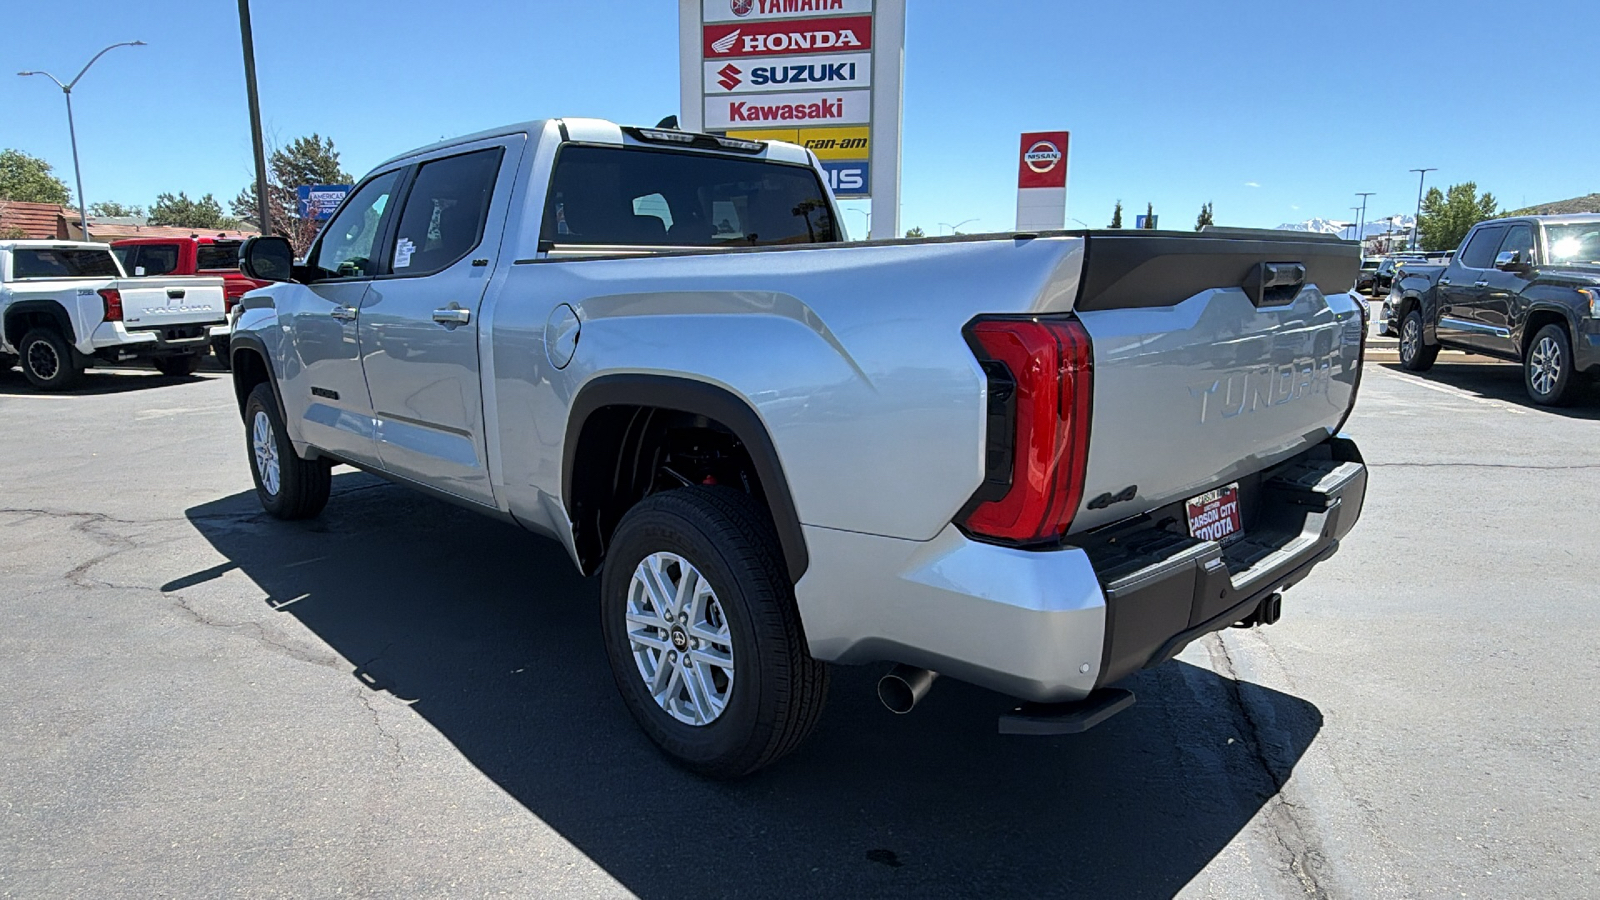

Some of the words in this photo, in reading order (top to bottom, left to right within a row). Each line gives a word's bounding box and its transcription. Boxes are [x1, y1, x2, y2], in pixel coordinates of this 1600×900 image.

[742, 30, 861, 51] HONDA
[750, 63, 855, 85] SUZUKI
[730, 98, 843, 121] Kawasaki
[804, 138, 867, 149] can-am
[142, 304, 213, 314] TACOMA
[1187, 356, 1334, 424] TUNDRA
[1190, 508, 1219, 530] CARSON
[1220, 501, 1237, 518] CITY
[1195, 516, 1234, 540] TOYOTA
